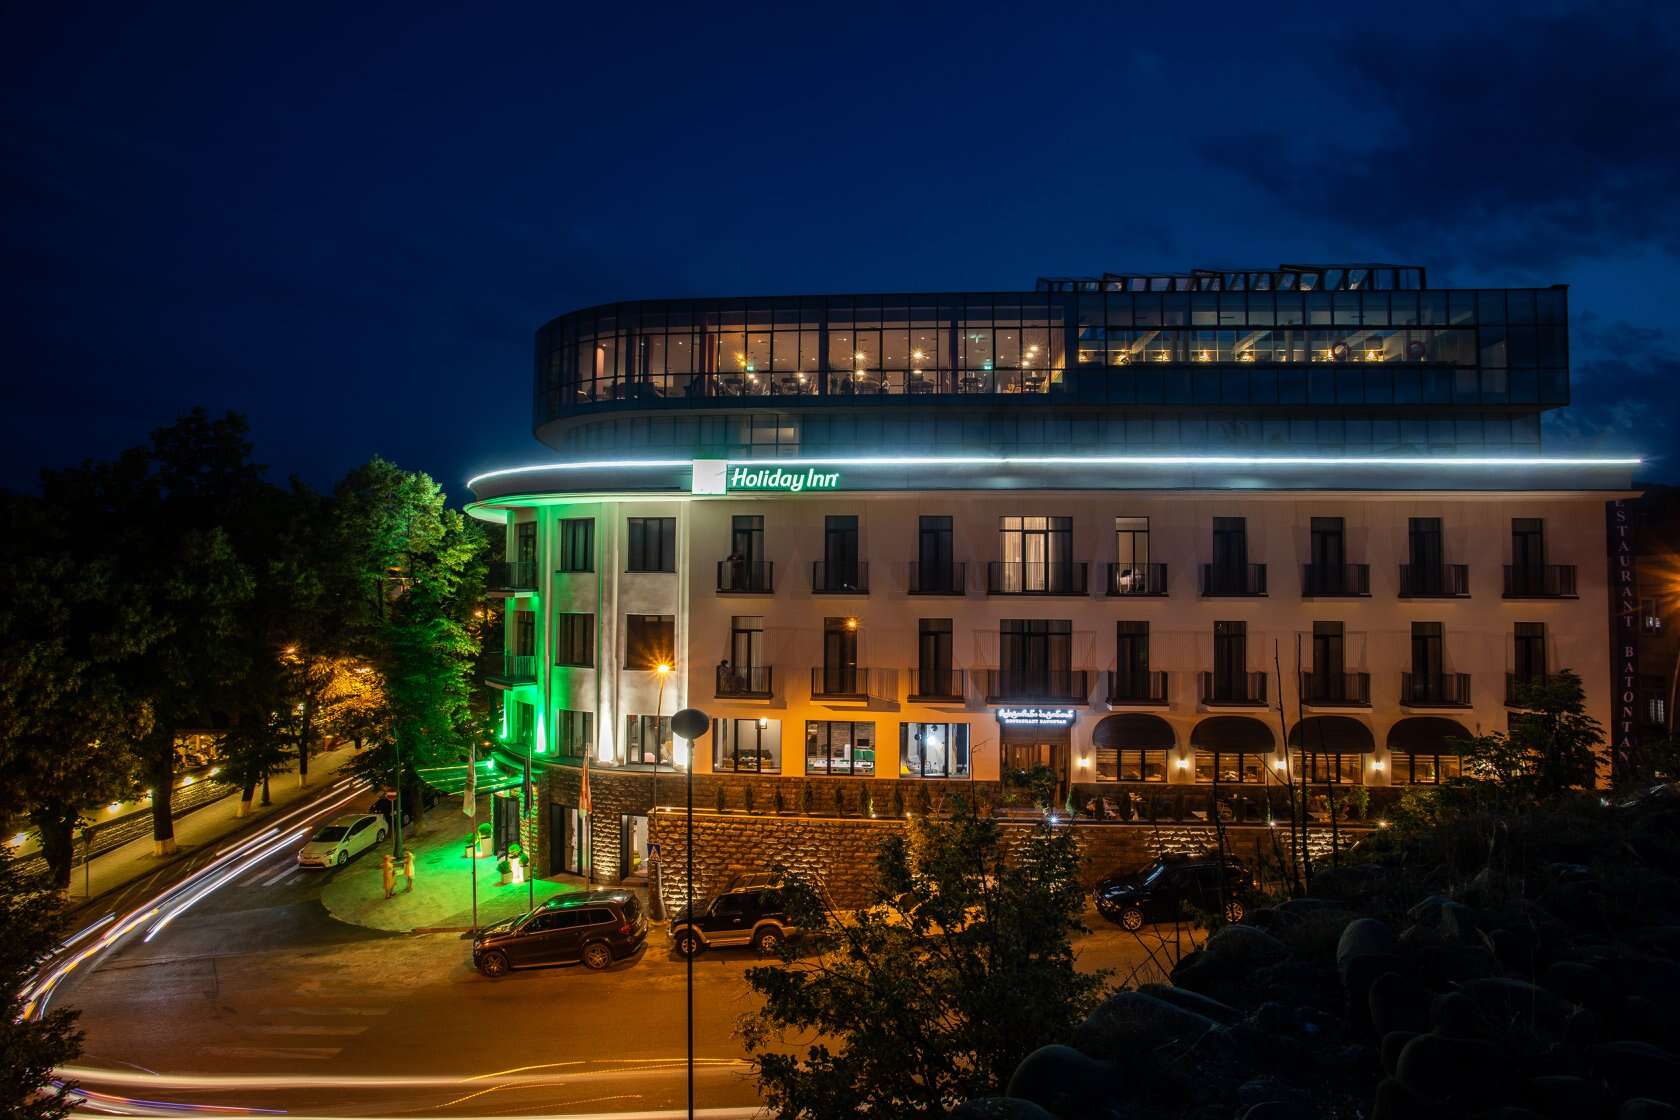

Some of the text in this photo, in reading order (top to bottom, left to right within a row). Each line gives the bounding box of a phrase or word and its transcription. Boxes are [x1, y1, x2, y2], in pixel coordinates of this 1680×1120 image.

[730, 467, 840, 492] Holiday Inn
[1619, 646, 1634, 762] BATONTAN
